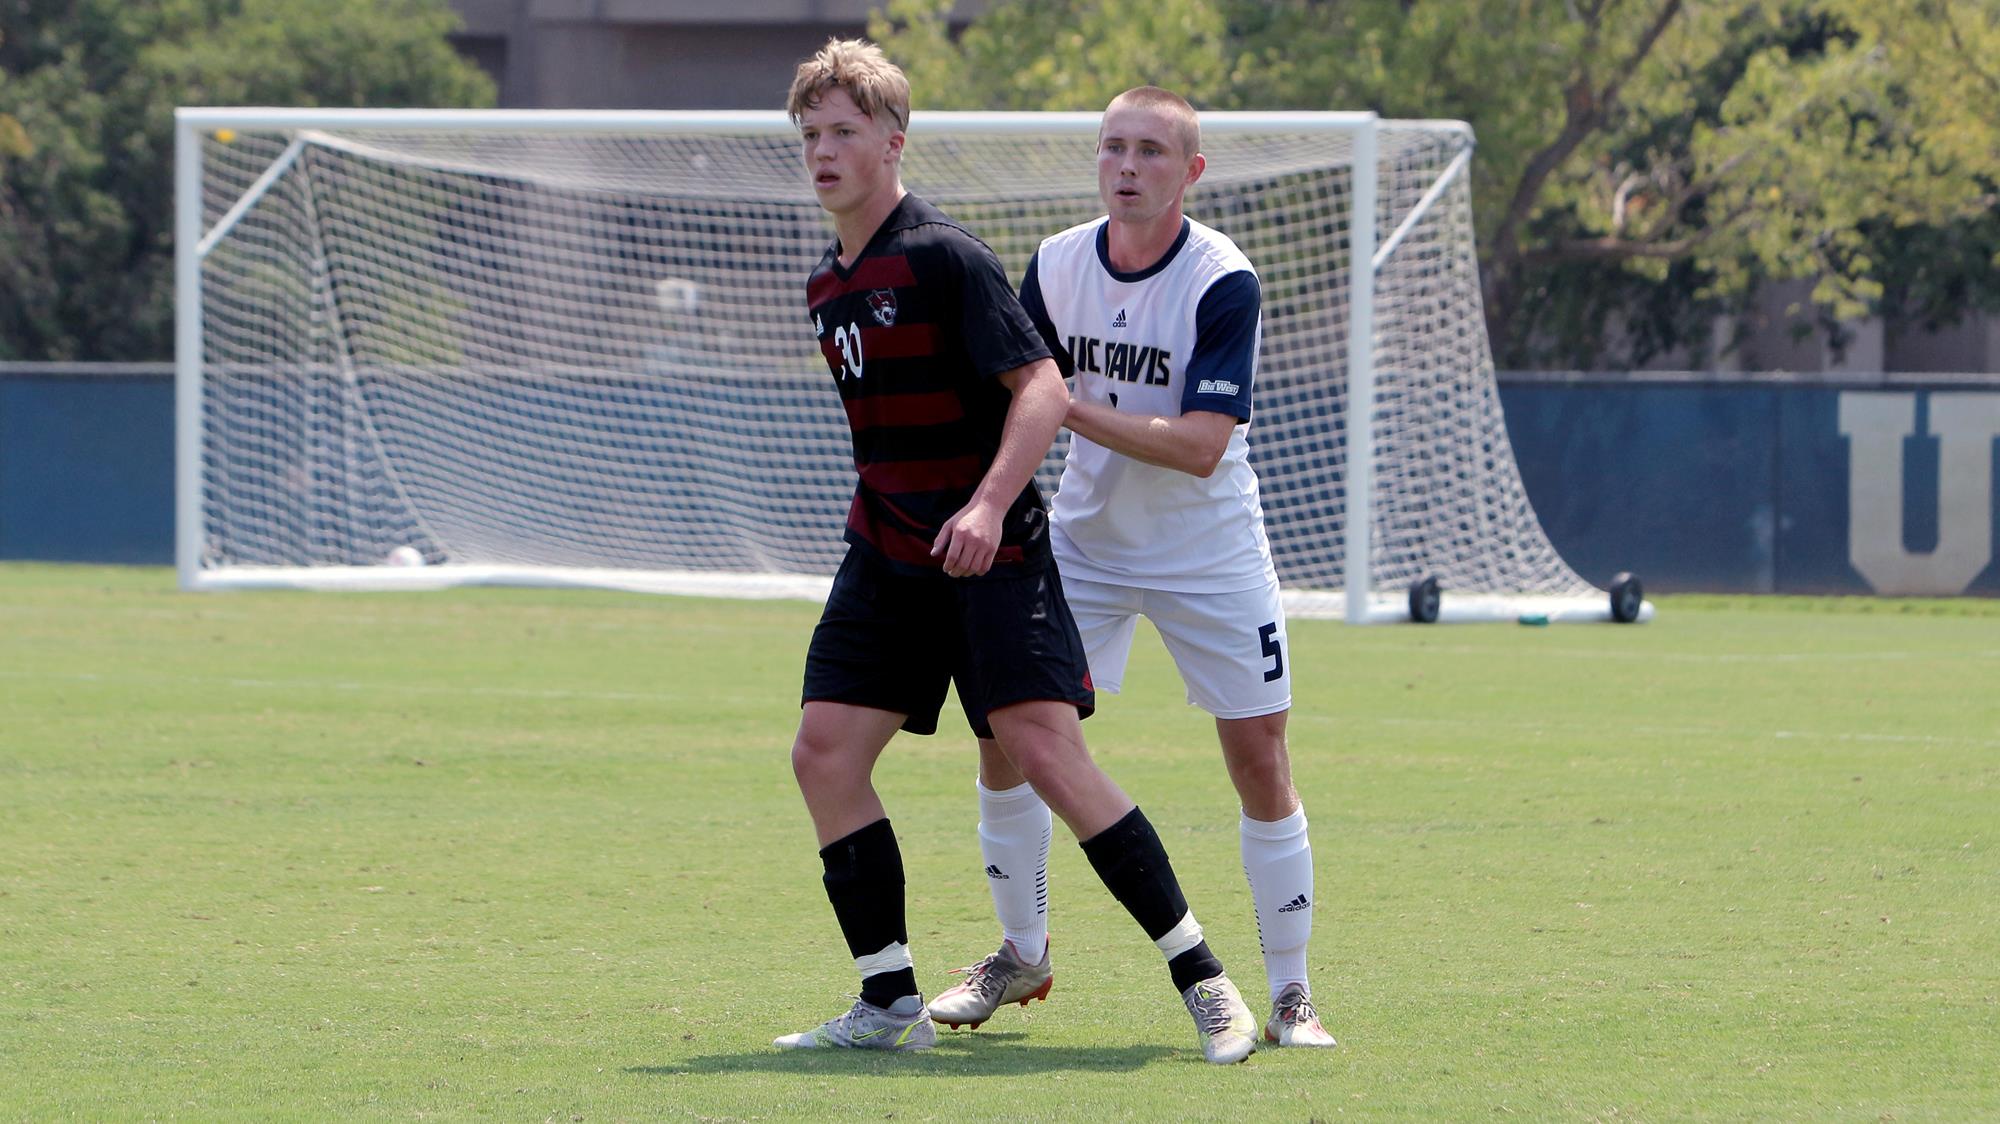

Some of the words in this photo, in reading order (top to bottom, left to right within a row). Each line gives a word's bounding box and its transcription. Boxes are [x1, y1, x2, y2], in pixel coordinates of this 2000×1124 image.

[834, 321, 863, 381] 30
[1067, 335, 1100, 374] UC
[1838, 391, 2000, 597] U
[1258, 621, 1284, 683] 5
[1278, 901, 1310, 913] adidas
